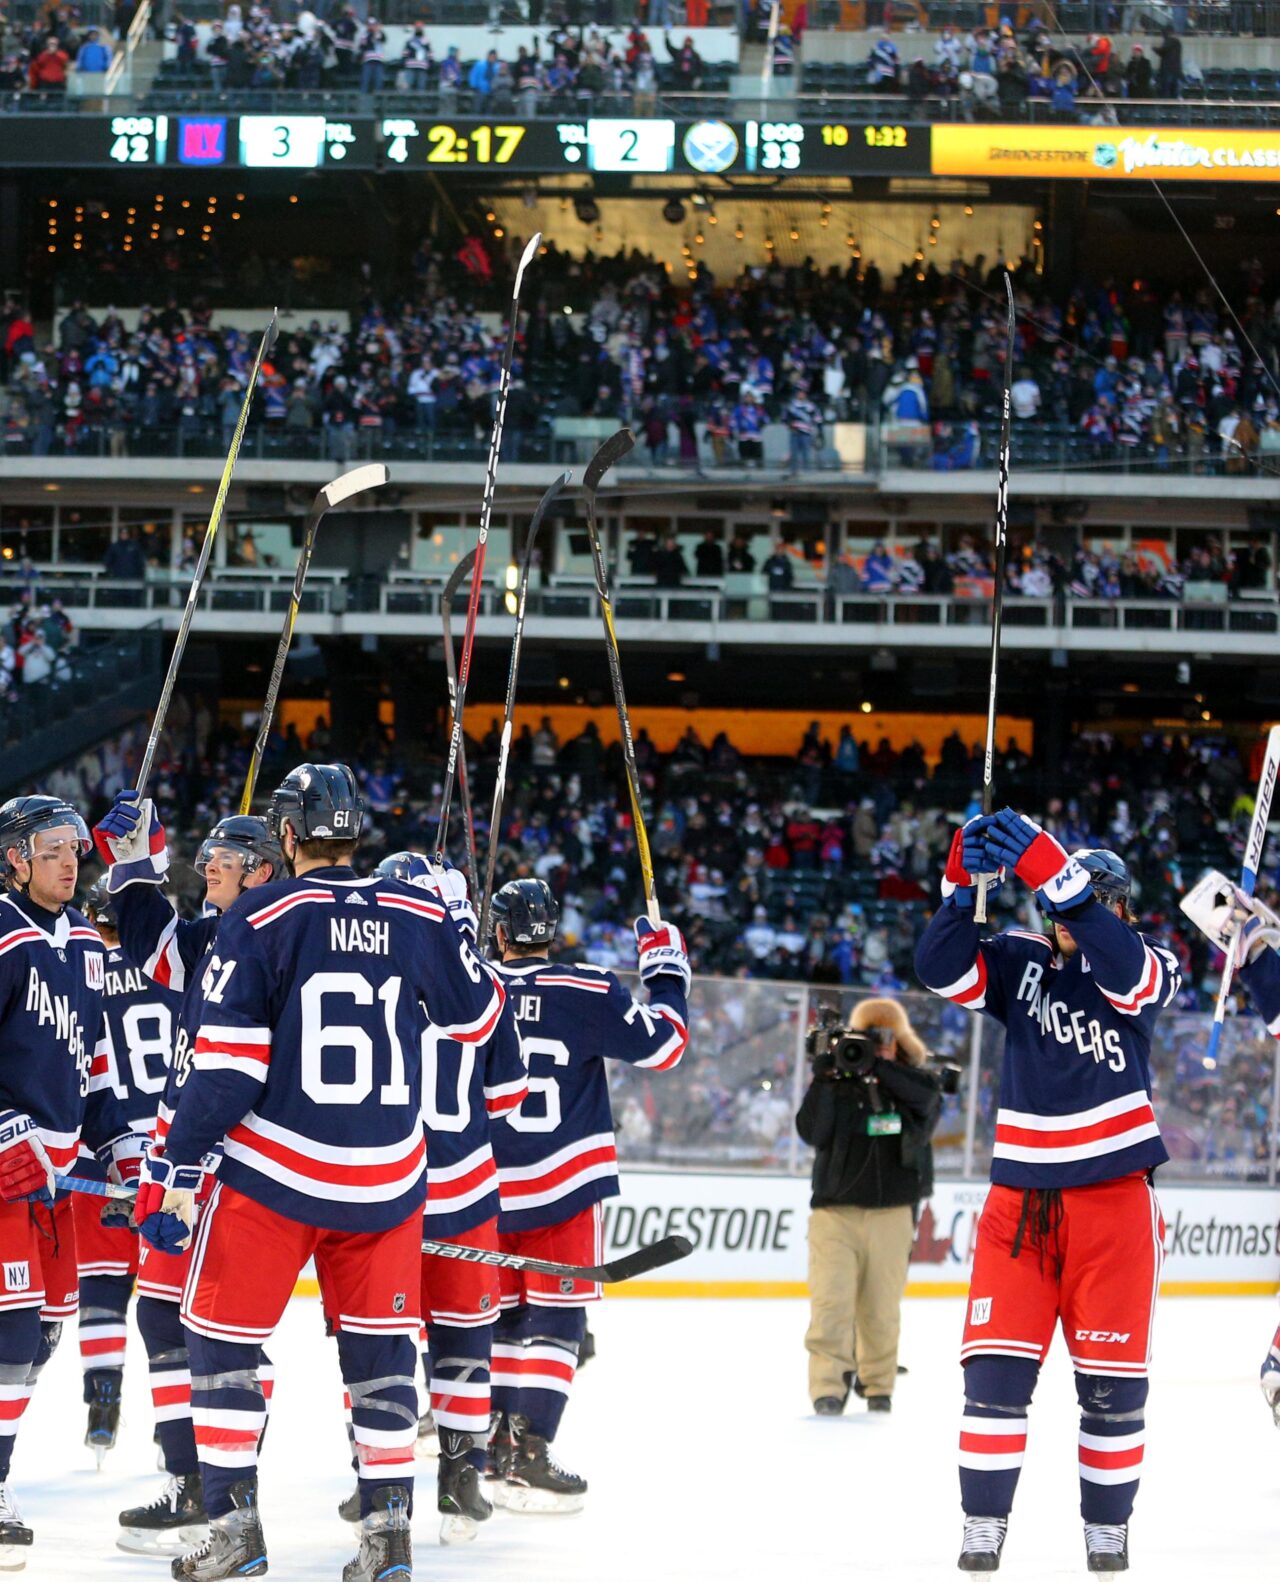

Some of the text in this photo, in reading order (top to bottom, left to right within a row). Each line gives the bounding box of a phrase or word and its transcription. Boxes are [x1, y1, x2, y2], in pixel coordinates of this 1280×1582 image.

[109, 136, 149, 162] 42
[272, 126, 290, 158] 3
[387, 136, 408, 163] 4
[427, 125, 526, 163] 2:17
[619, 129, 639, 162] 2
[822, 125, 848, 146] 10
[762, 142, 801, 169] 33
[989, 147, 1089, 161] BRIDGESTONE
[1213, 147, 1280, 167] CLASS
[446, 721, 461, 775] EASTON
[333, 810, 350, 828] 61
[1249, 756, 1277, 867] BAUER
[330, 917, 390, 956] NASH
[530, 921, 546, 936] 76
[104, 967, 148, 996] TAAL
[201, 955, 237, 1004] 61
[513, 995, 542, 1022] JEI
[1016, 960, 1127, 1073] RANGERS
[25, 966, 93, 1098] RANGES
[300, 972, 410, 1105] 61
[506, 1036, 571, 1134] 6
[604, 1205, 795, 1250] IDGESTONE
[421, 1240, 527, 1271] BAUER
[8, 1269, 28, 1287] N.Y.
[973, 1300, 990, 1323] N.Y.
[1075, 1329, 1132, 1344] CCM
